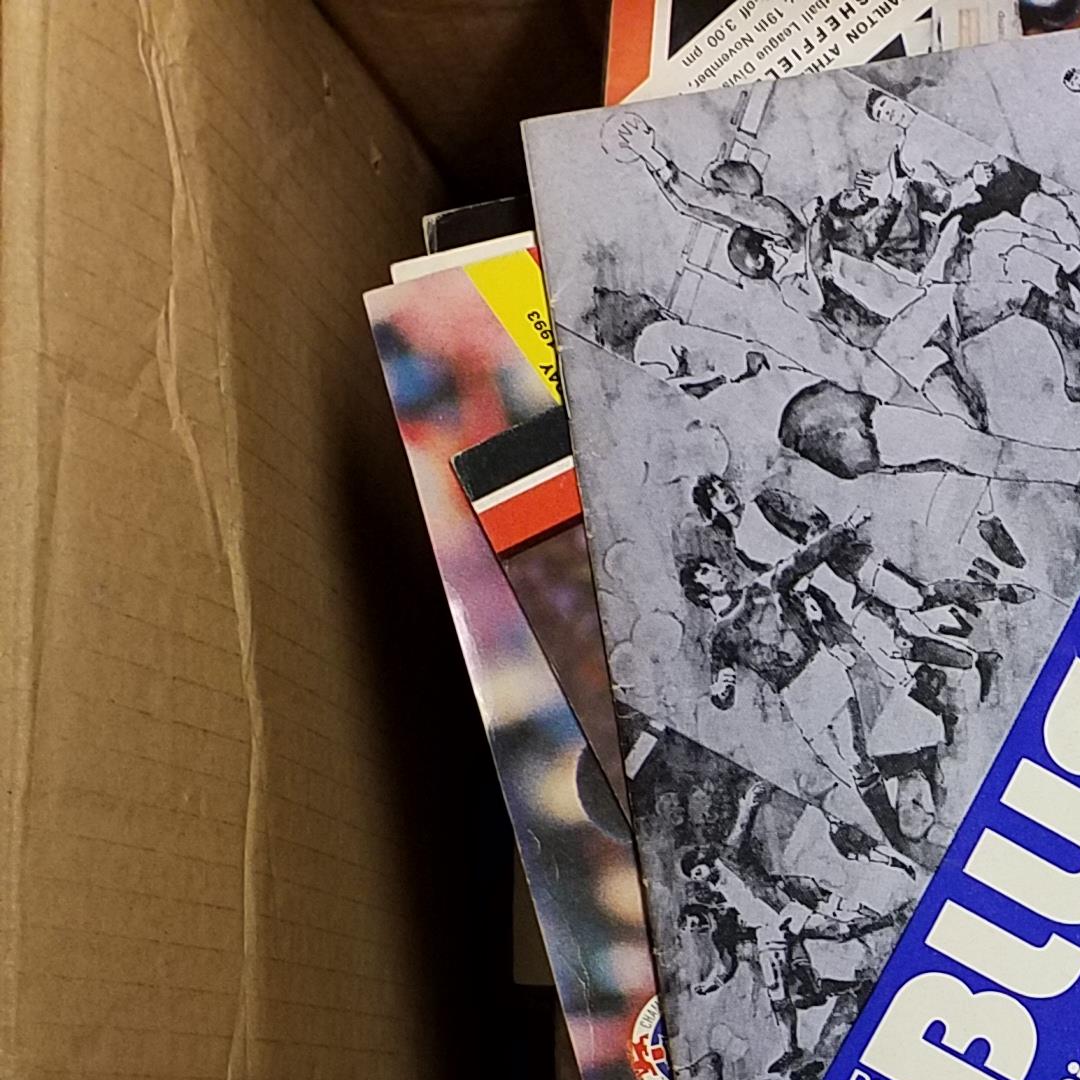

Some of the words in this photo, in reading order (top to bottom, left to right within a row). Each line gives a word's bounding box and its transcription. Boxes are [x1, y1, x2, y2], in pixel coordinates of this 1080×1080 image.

[707, 18, 737, 48] 3.00
[756, 7, 785, 33] 19th
[849, 0, 902, 43] ARLTON
[681, 48, 704, 68] pm
[756, 21, 801, 60] League
[757, 0, 869, 82] SHEFFIEL
[688, 33, 755, 87] November,
[802, 43, 841, 75] ATHL
